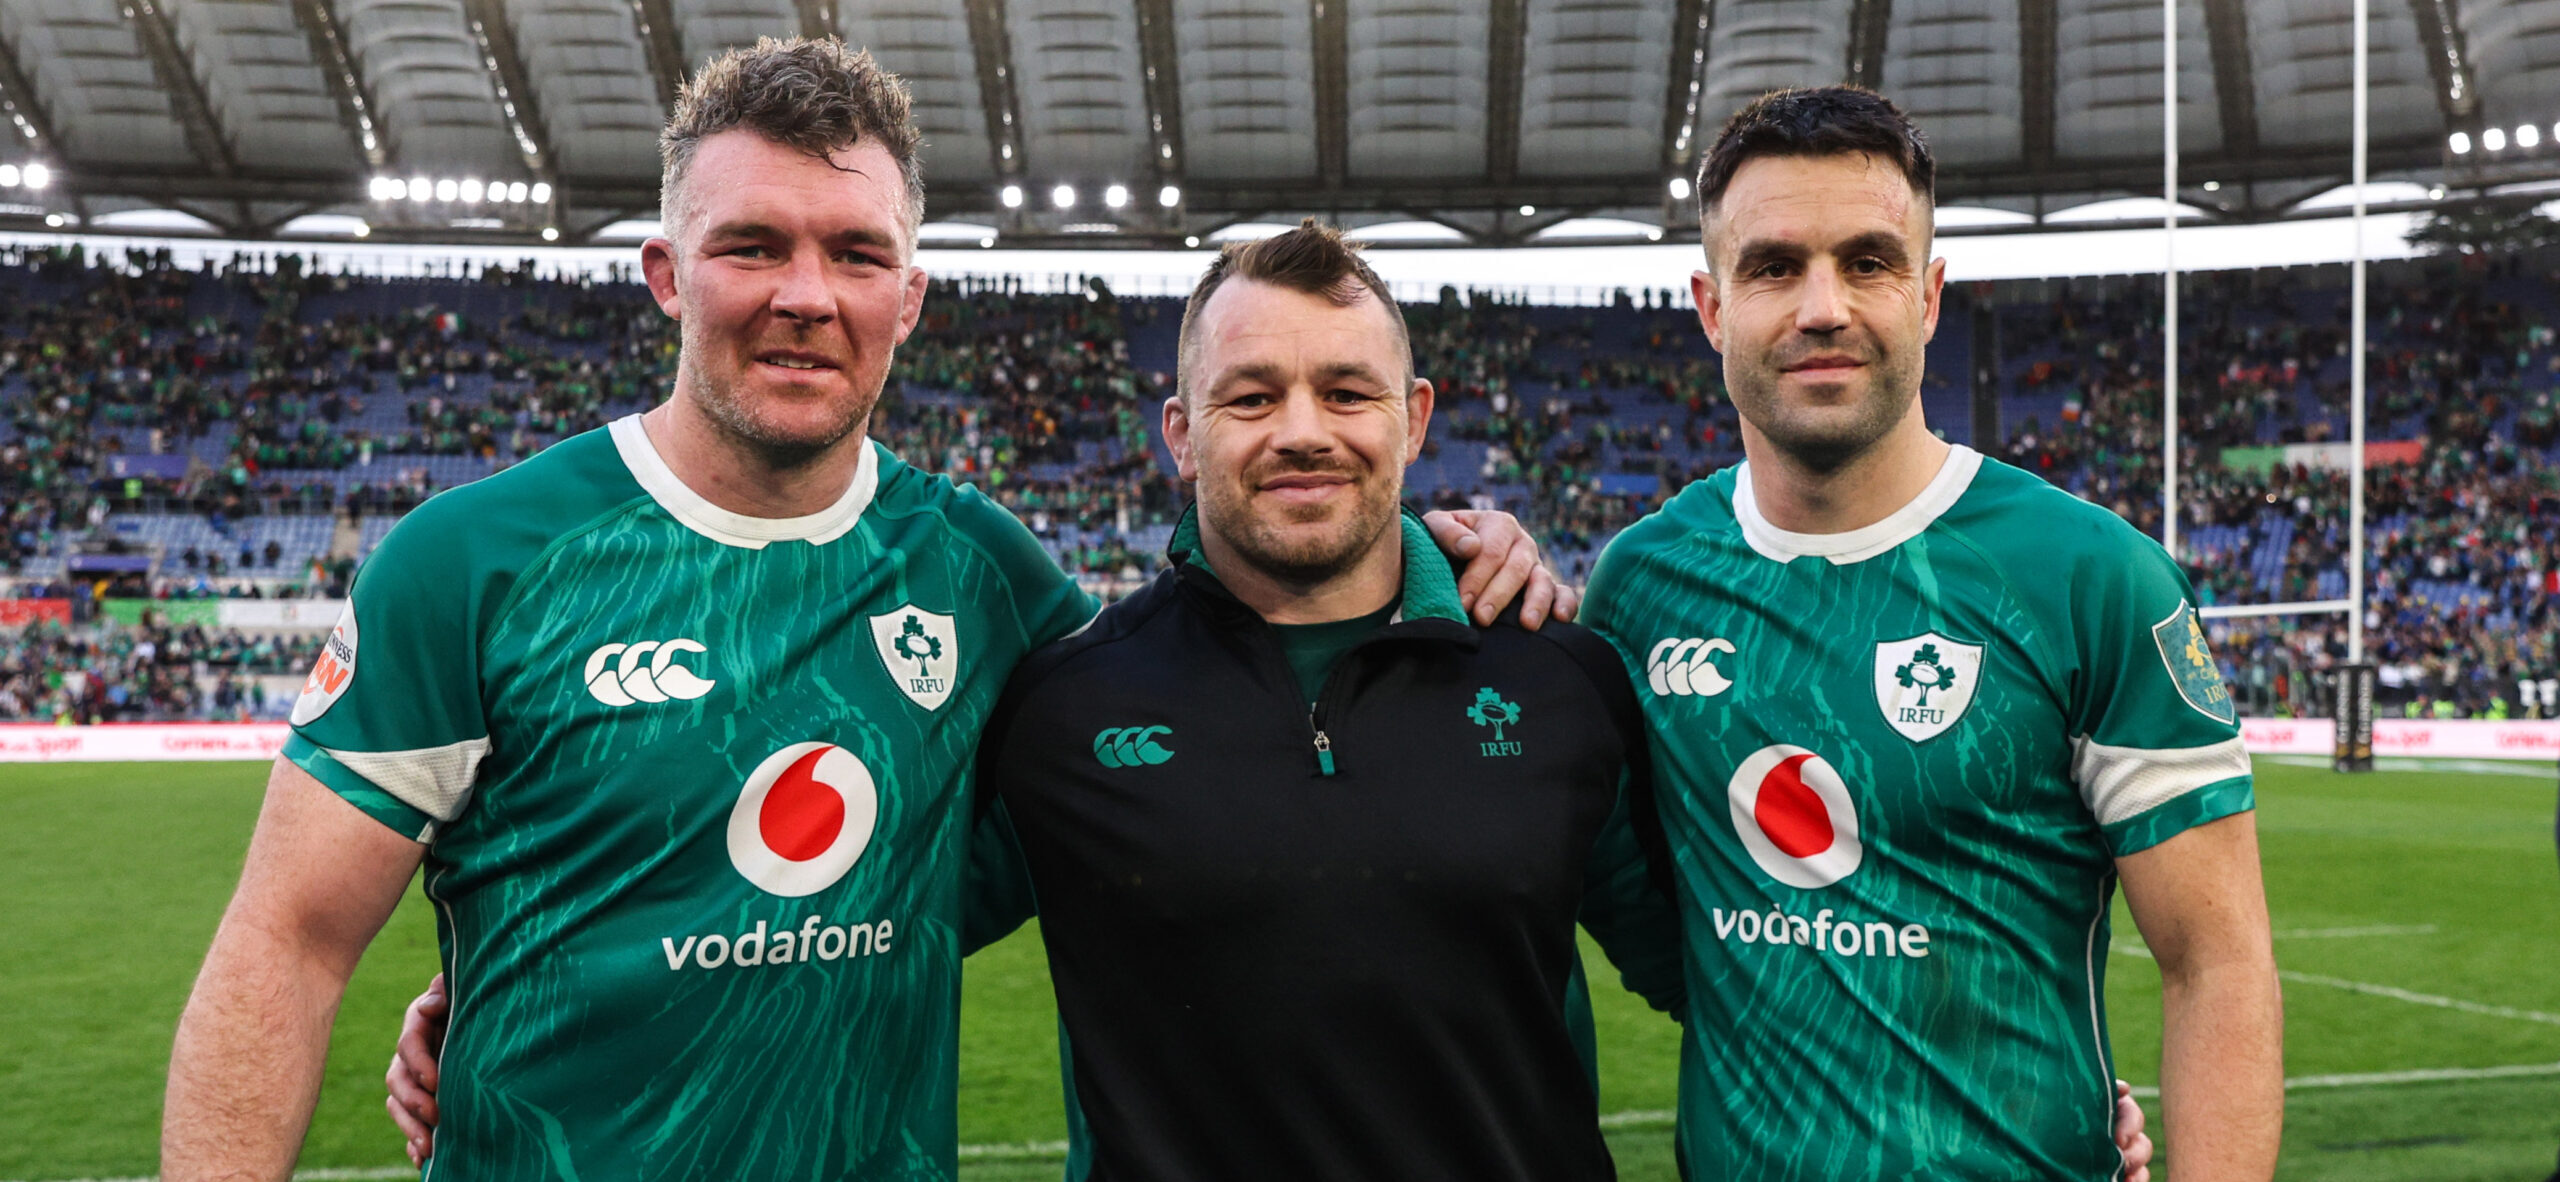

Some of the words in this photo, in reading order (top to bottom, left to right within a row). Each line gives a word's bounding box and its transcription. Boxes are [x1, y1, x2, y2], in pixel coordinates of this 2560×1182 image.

[910, 679, 945, 693] IRFU
[2204, 682, 2226, 704] IR
[1898, 708, 1945, 724] IRFU
[1480, 741, 1522, 757] IRFU
[1712, 903, 1930, 958] vodafone
[661, 915, 893, 971] vodafone
